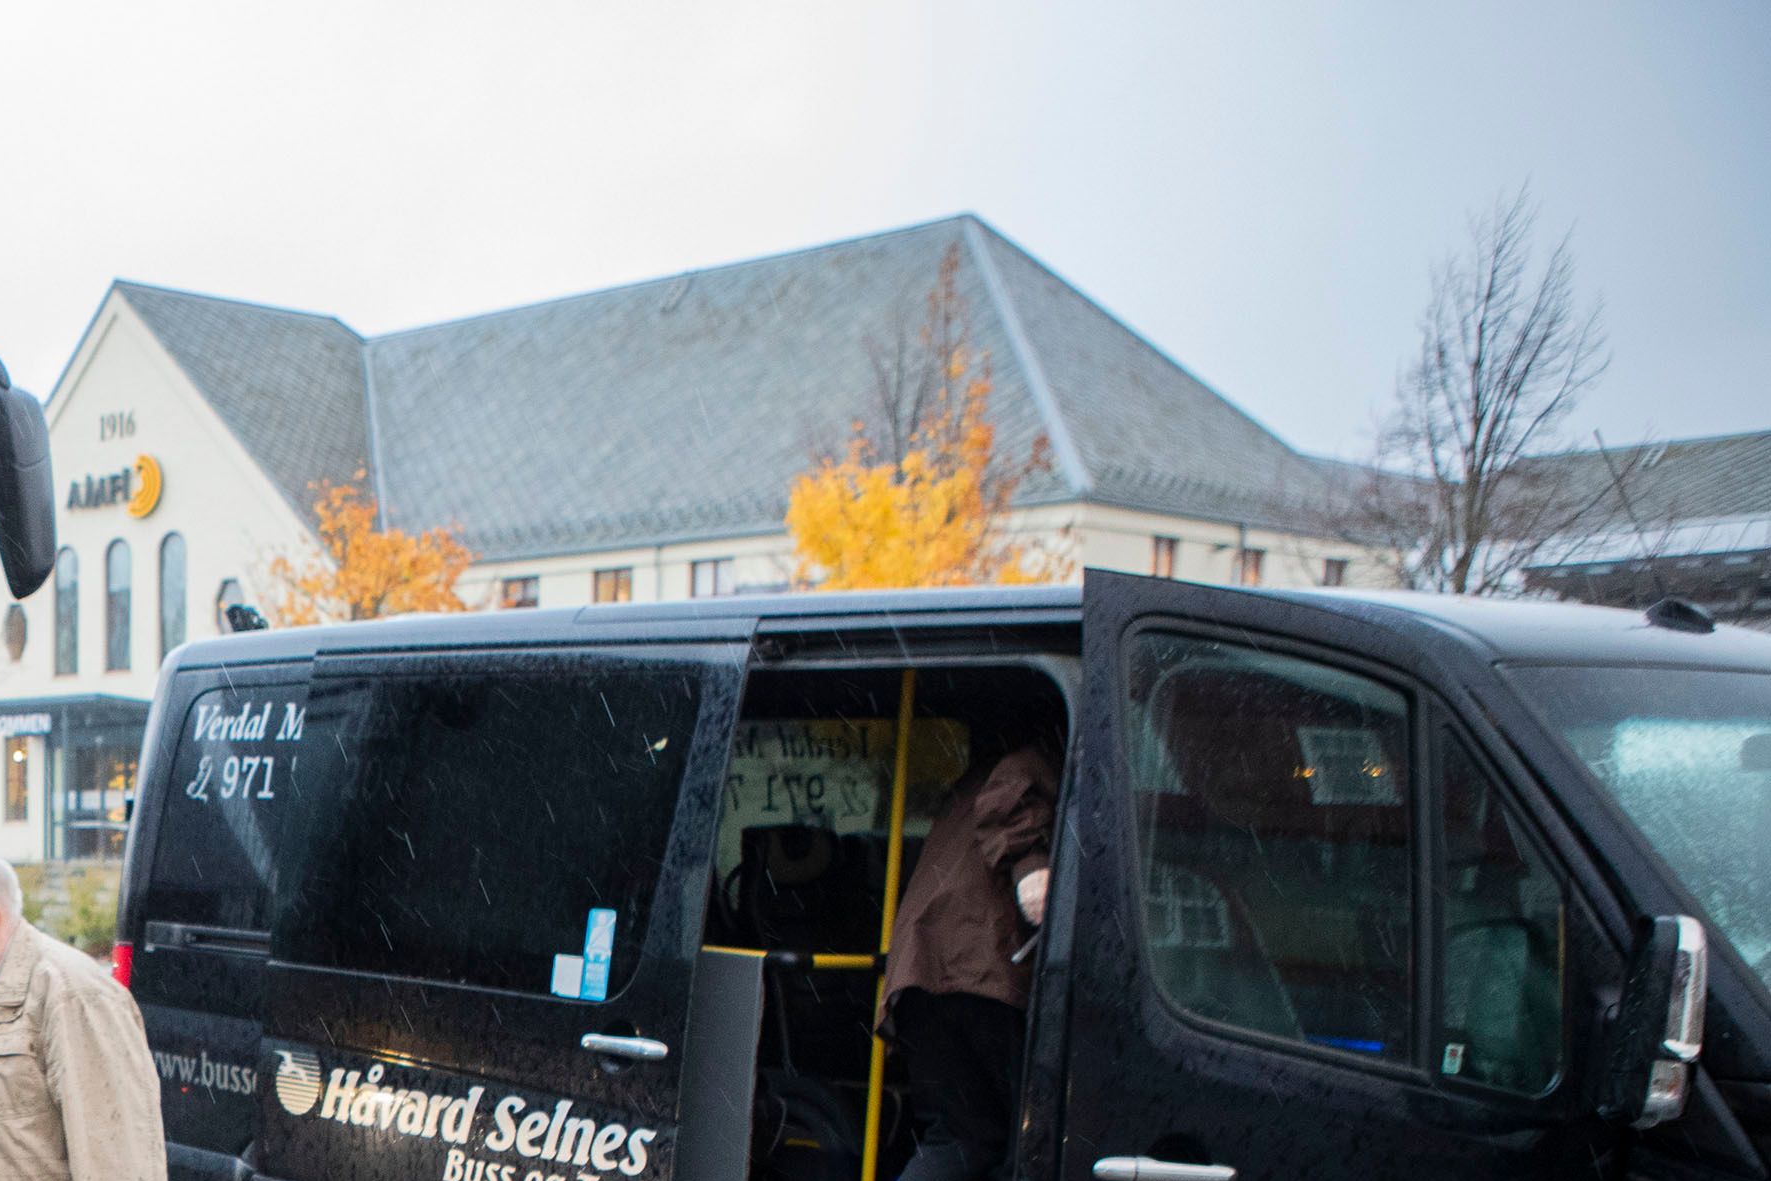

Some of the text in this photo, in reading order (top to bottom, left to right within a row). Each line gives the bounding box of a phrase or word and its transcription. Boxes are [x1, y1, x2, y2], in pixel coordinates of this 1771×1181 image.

[100, 411, 136, 441] 1916
[67, 467, 131, 510] AMFI
[193, 702, 272, 742] Verdal
[220, 755, 275, 800] 971
[320, 1064, 658, 1176] Håvard Selnes
